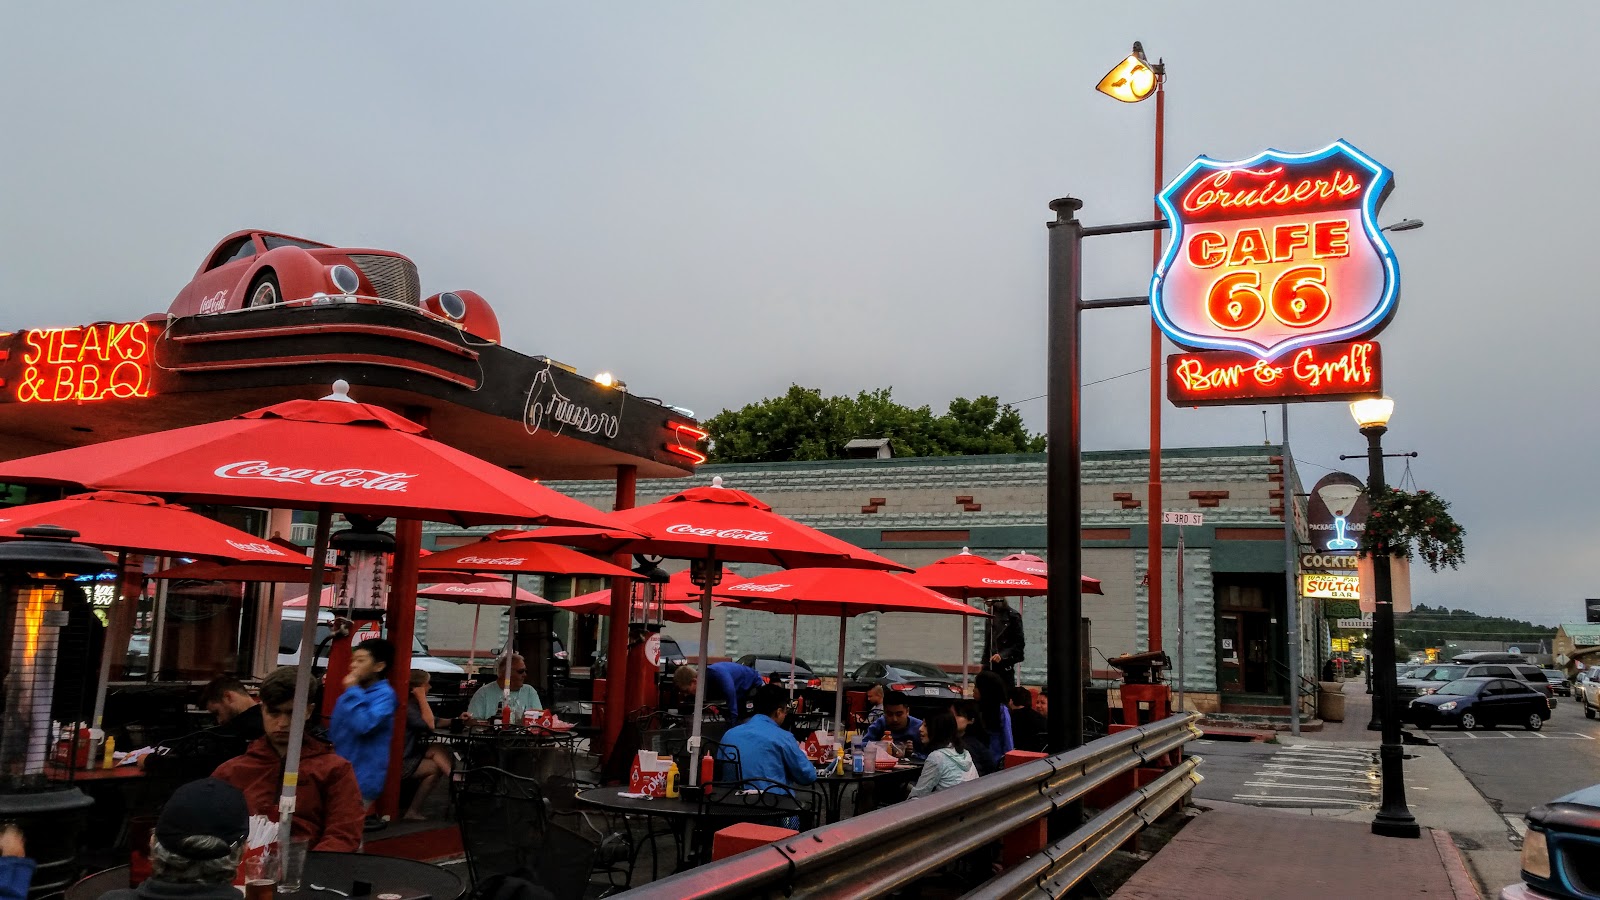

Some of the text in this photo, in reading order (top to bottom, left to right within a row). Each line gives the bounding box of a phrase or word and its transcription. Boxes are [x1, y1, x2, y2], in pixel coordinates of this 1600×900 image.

[1183, 167, 1361, 211] Cruiser's
[1187, 219, 1350, 269] CAFE
[199, 290, 229, 315] Coca-Cola
[1206, 265, 1331, 331] 66
[24, 322, 149, 364] STEAKS
[18, 366, 51, 402] &
[1176, 343, 1372, 391] Bar & Grill
[213, 460, 418, 492] Coca-Cola
[666, 523, 774, 542] Coca-Cola
[1165, 513, 1201, 525] S 3RD ST
[981, 577, 1034, 586] Coca-Cola
[641, 771, 666, 795] Coke
